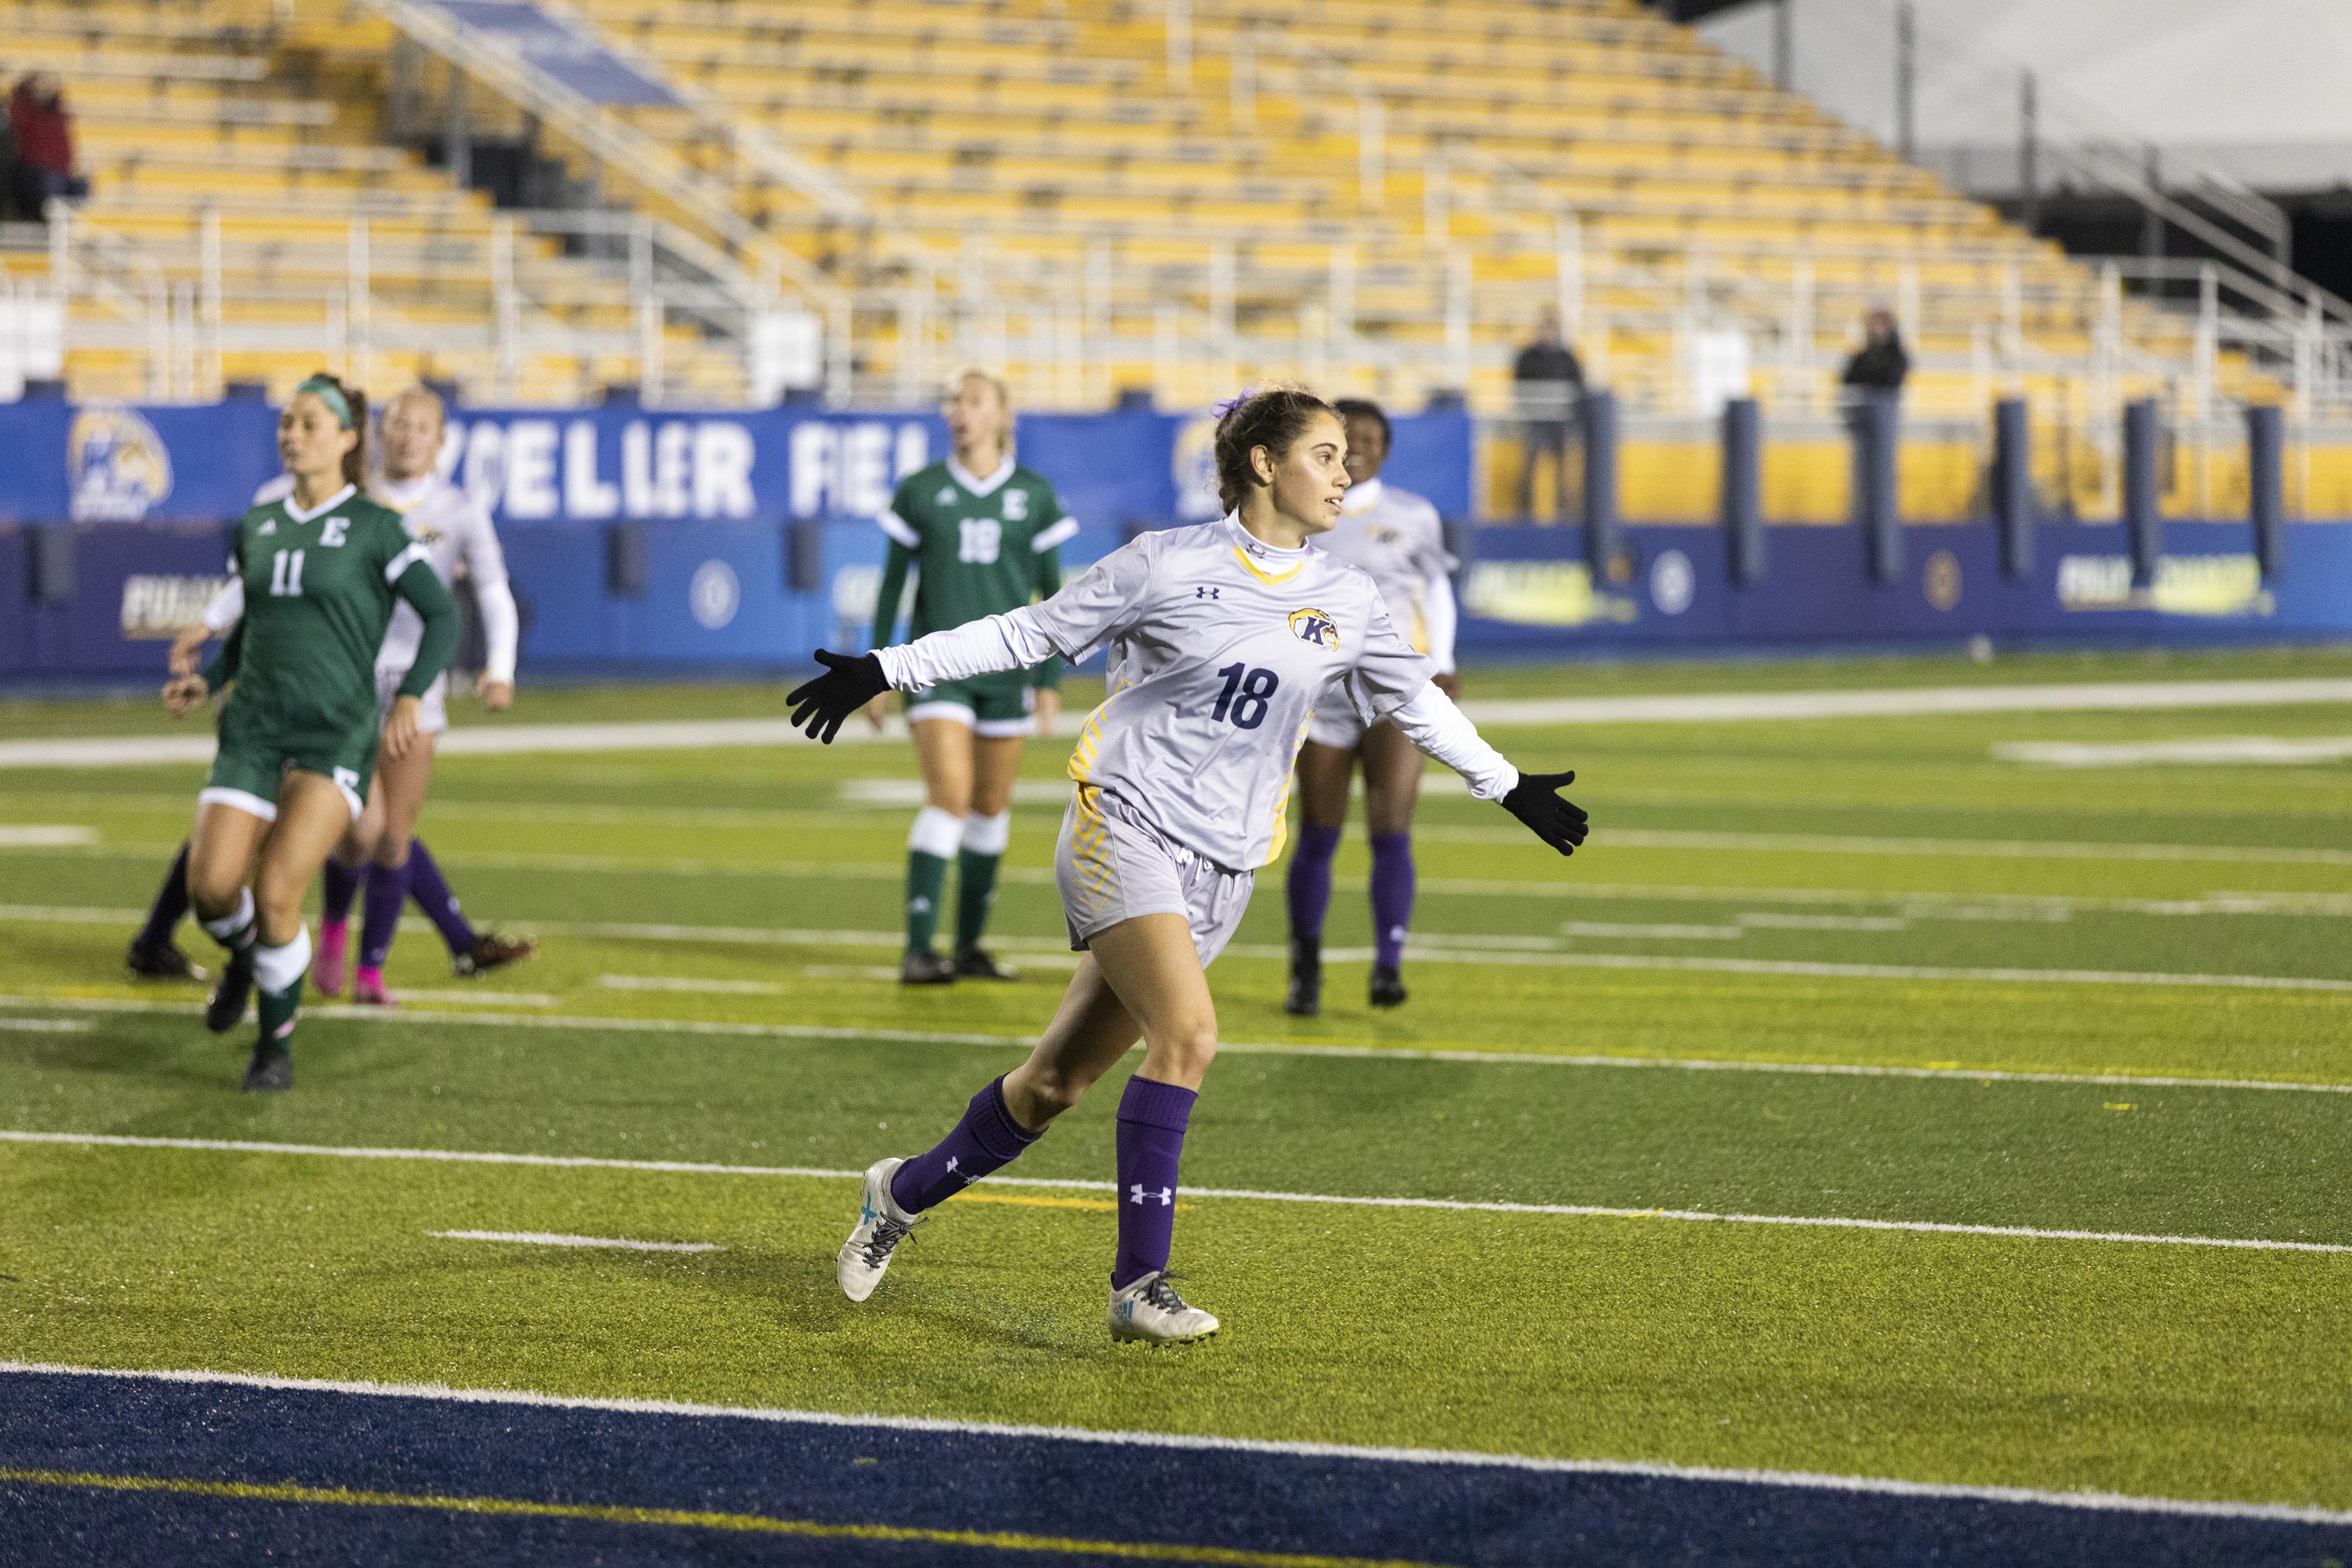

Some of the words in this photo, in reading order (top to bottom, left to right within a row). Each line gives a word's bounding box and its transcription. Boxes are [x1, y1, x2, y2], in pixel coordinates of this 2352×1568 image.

[1002, 488, 1029, 521] E
[318, 516, 352, 547] E
[269, 549, 306, 597] 11
[1301, 615, 1331, 646] K
[1211, 662, 1279, 730] 18
